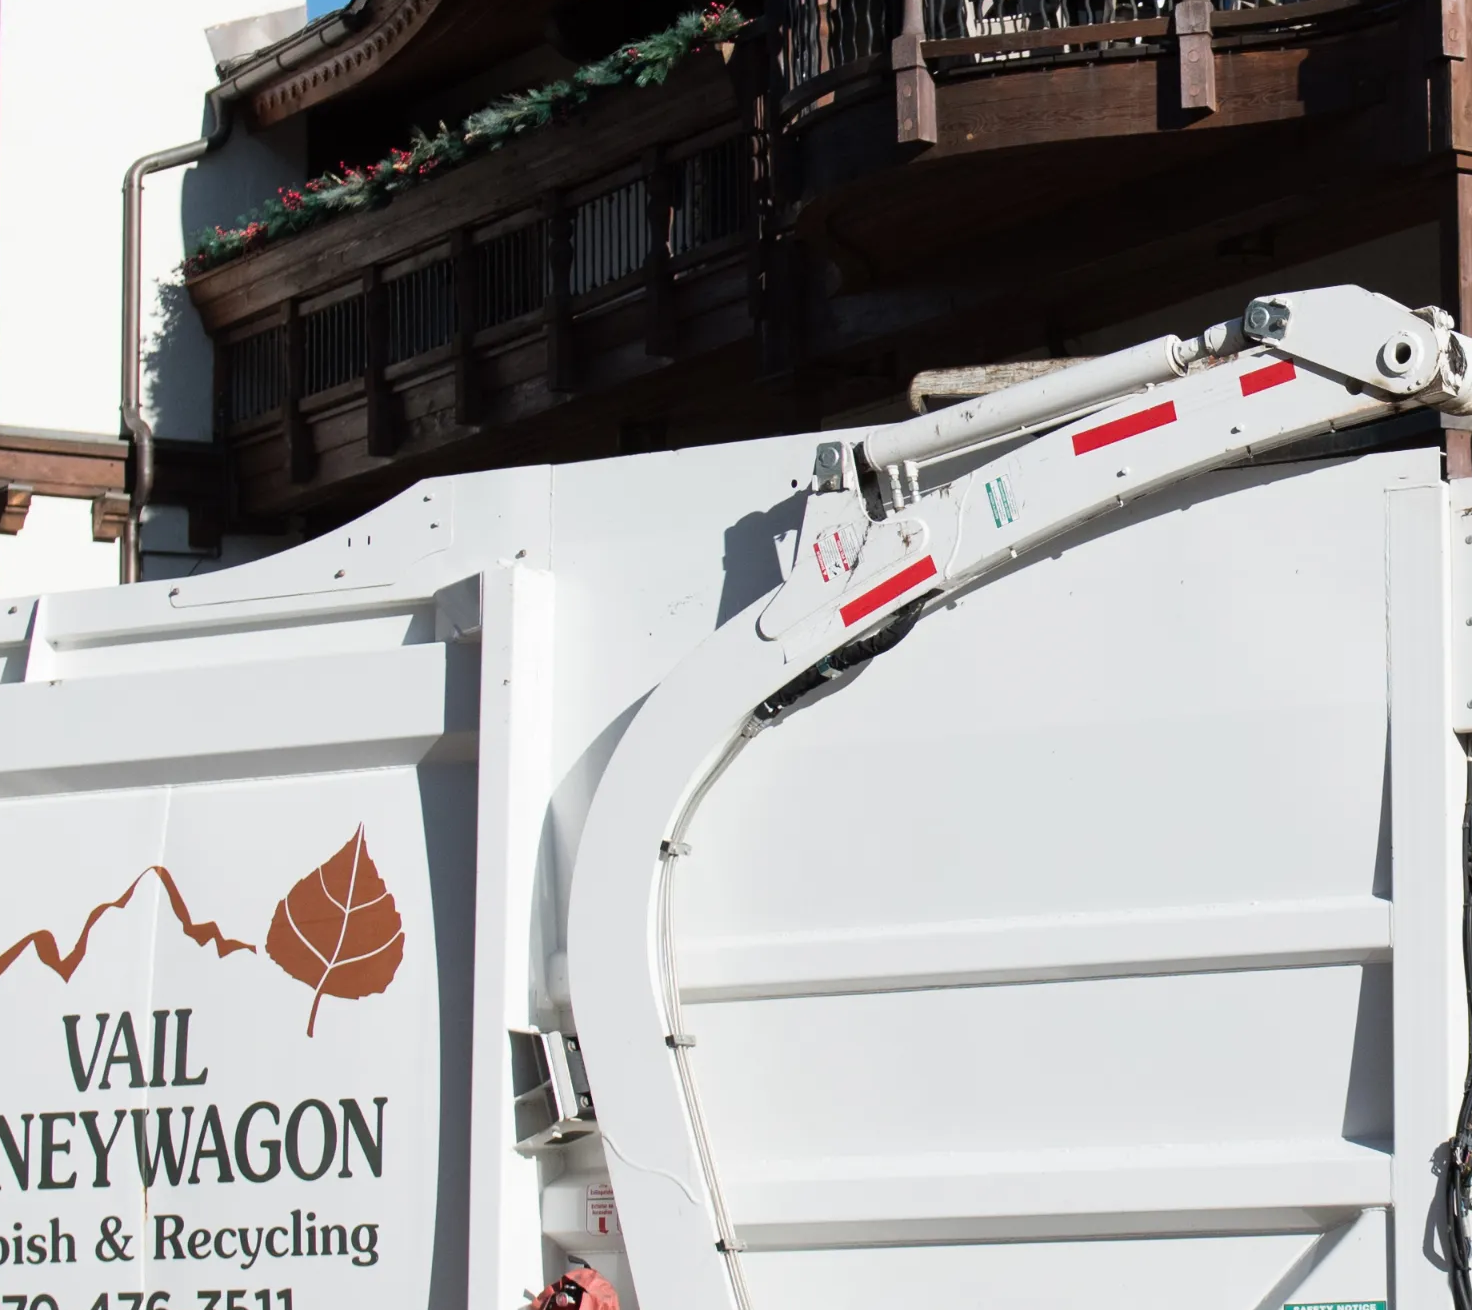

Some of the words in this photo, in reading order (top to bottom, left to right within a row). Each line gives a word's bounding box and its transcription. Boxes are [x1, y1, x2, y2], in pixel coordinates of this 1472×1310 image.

[62, 1008, 209, 1091] VAIL
[94, 1215, 135, 1263] &
[153, 1208, 380, 1270] Recycling
